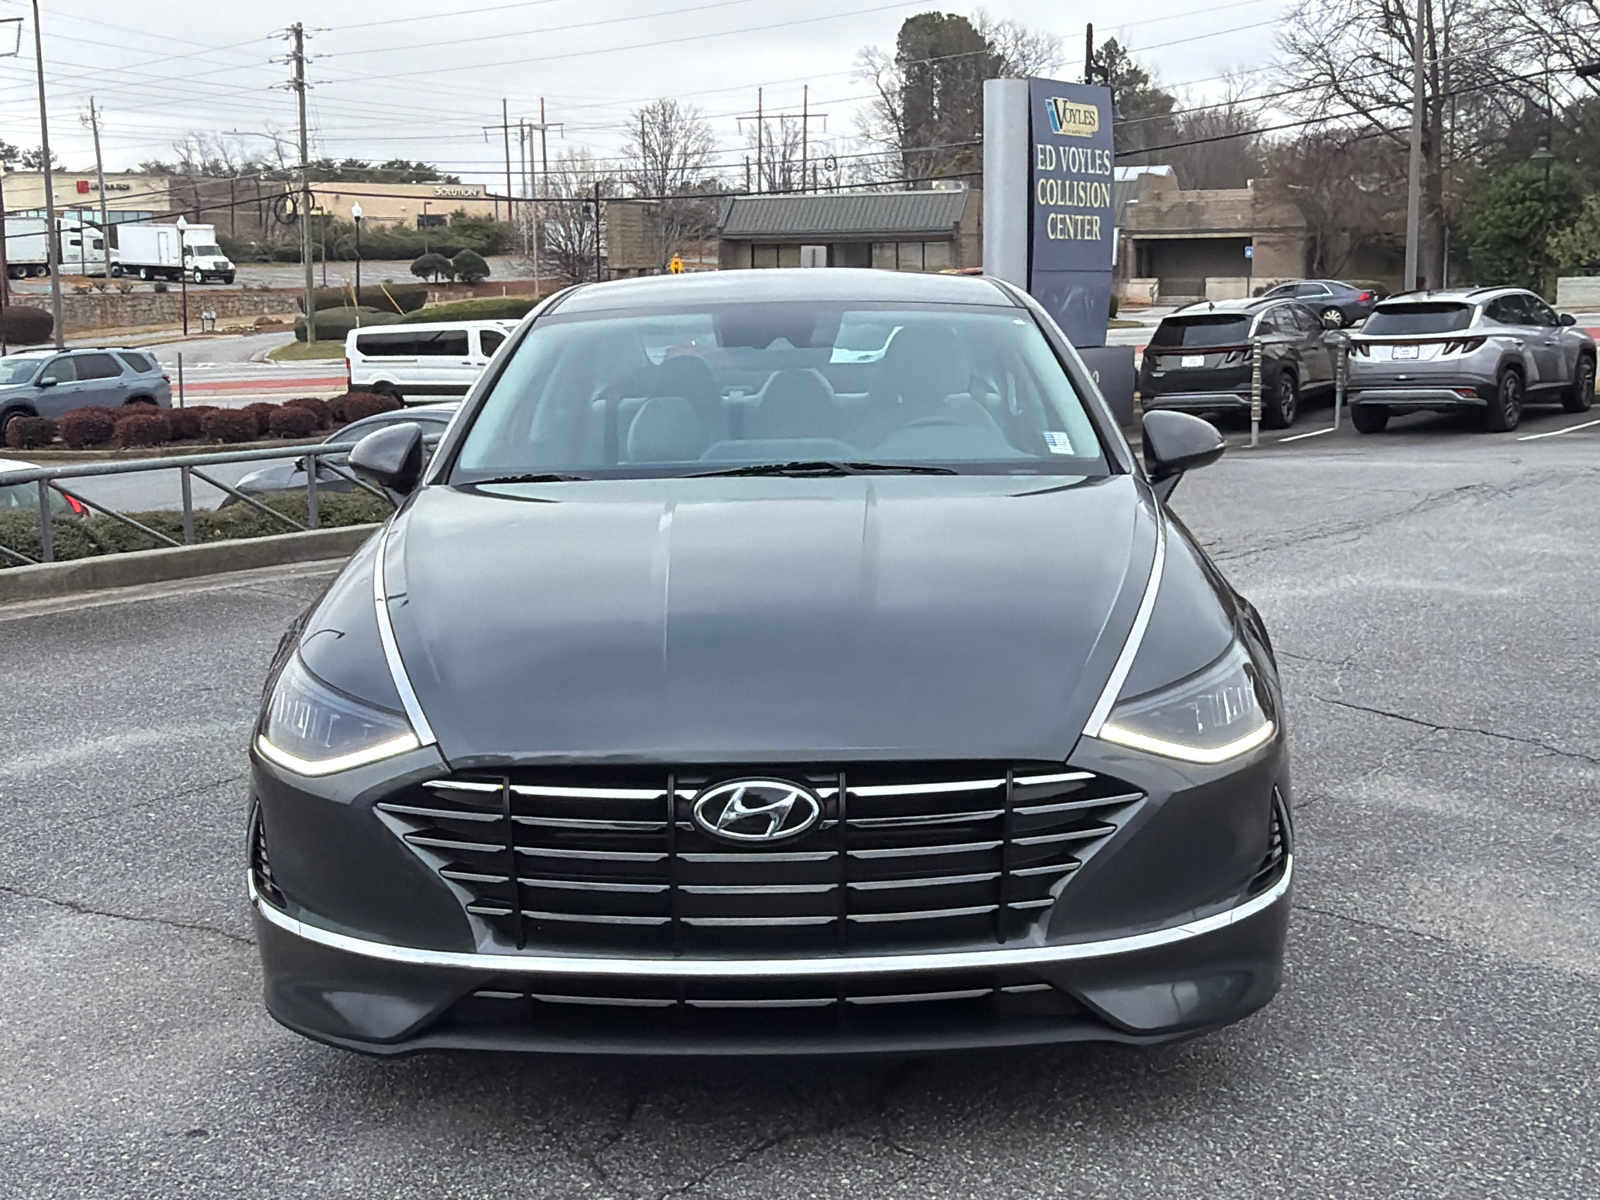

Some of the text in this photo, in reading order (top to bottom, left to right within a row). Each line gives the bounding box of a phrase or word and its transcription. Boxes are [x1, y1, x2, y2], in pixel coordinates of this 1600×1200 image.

[1053, 98, 1096, 129] VOYLES
[1036, 144, 1111, 176] ED VOYLES
[1037, 178, 1111, 208] COLLISION
[1047, 212, 1101, 241] CENTER
